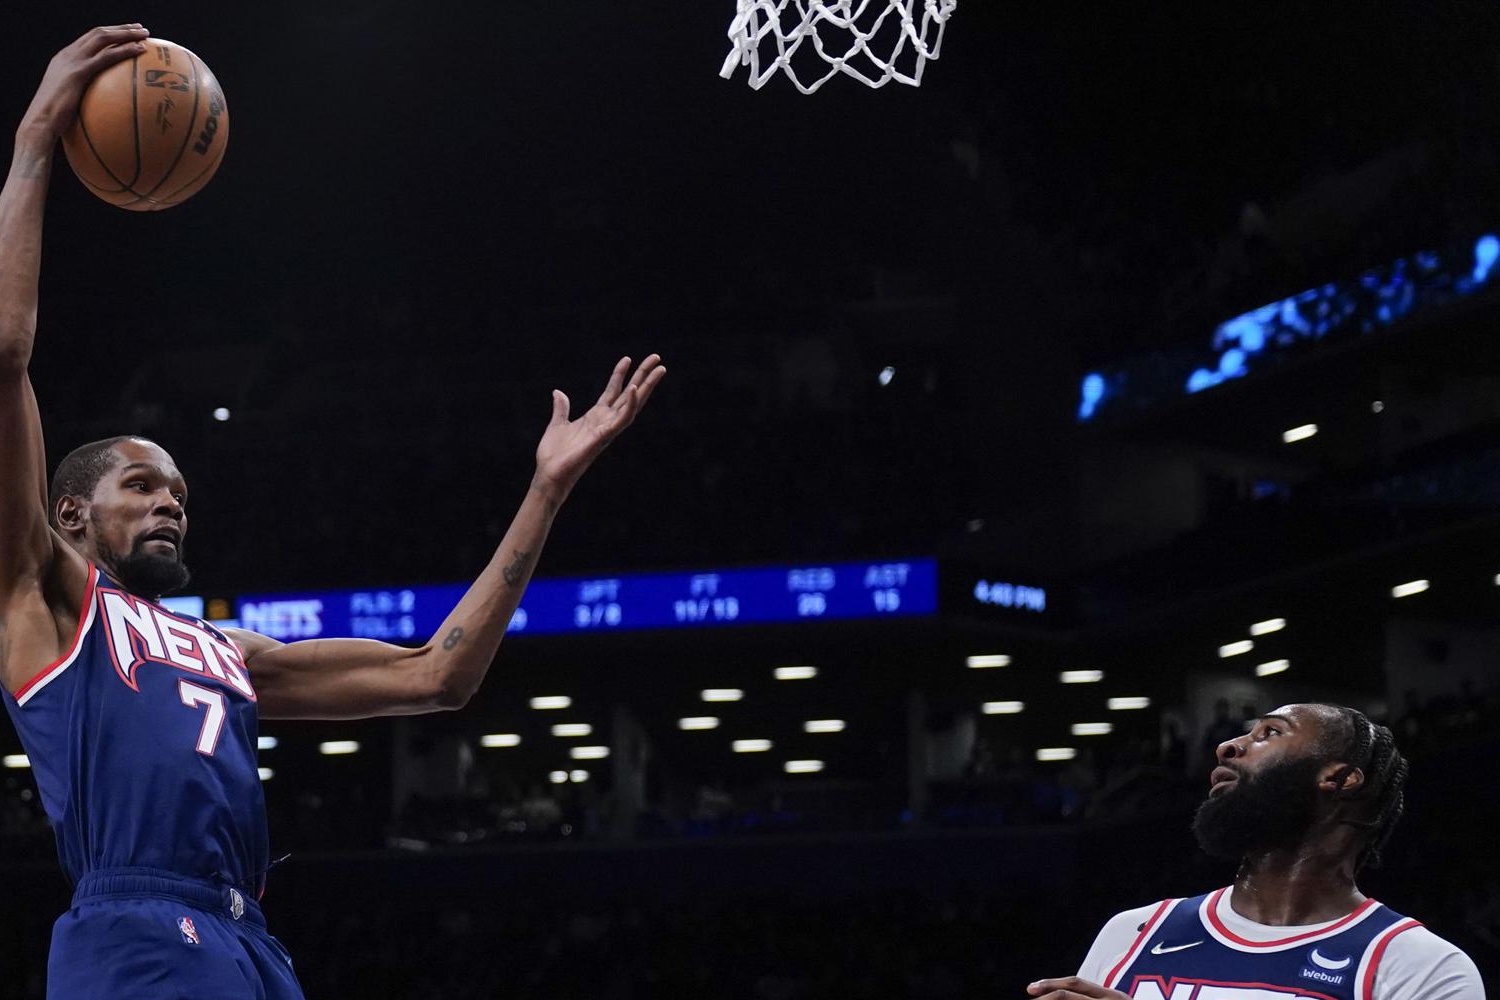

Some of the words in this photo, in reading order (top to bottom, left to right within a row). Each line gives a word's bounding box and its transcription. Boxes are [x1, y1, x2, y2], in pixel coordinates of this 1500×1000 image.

[98, 588, 257, 700] NETS
[241, 600, 323, 638] NETS
[179, 678, 226, 757] 7
[1303, 968, 1342, 984] Webull
